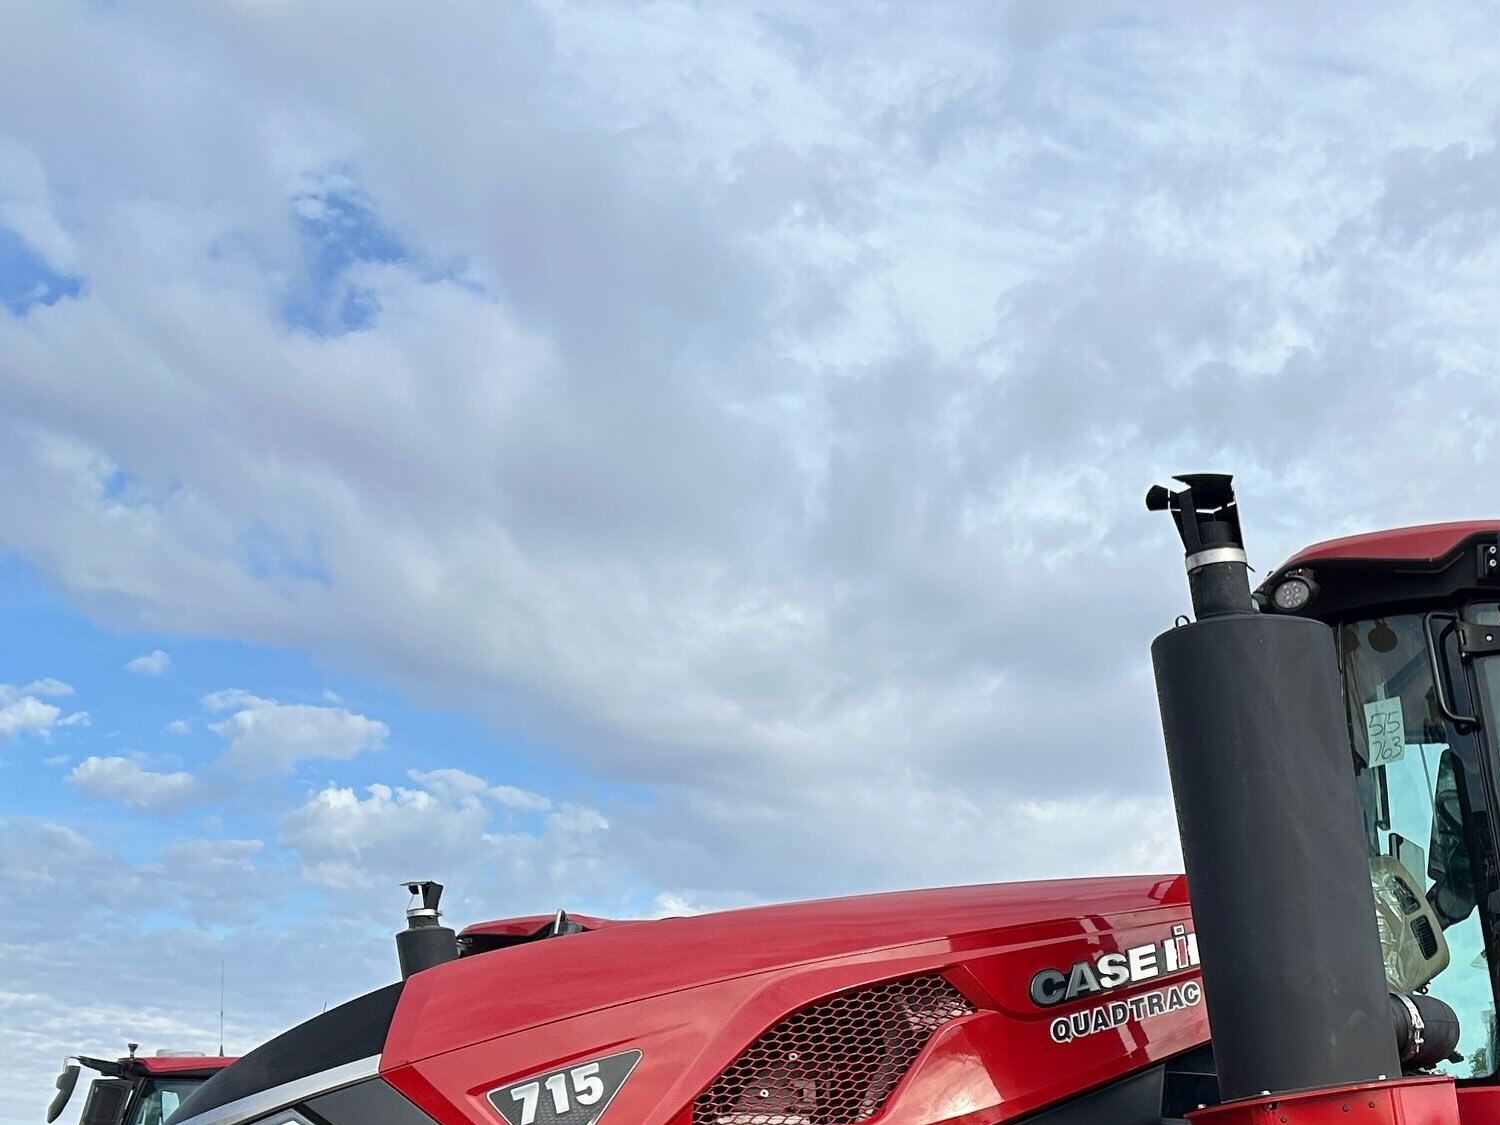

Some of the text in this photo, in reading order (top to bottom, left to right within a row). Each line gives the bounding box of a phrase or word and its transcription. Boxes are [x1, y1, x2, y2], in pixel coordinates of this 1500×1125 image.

[1369, 711, 1400, 737] 515
[1372, 736, 1403, 762] 763
[1030, 942, 1159, 1005] CASE
[1050, 981, 1201, 1043] QUADTRAC
[510, 1062, 605, 1125] 715
